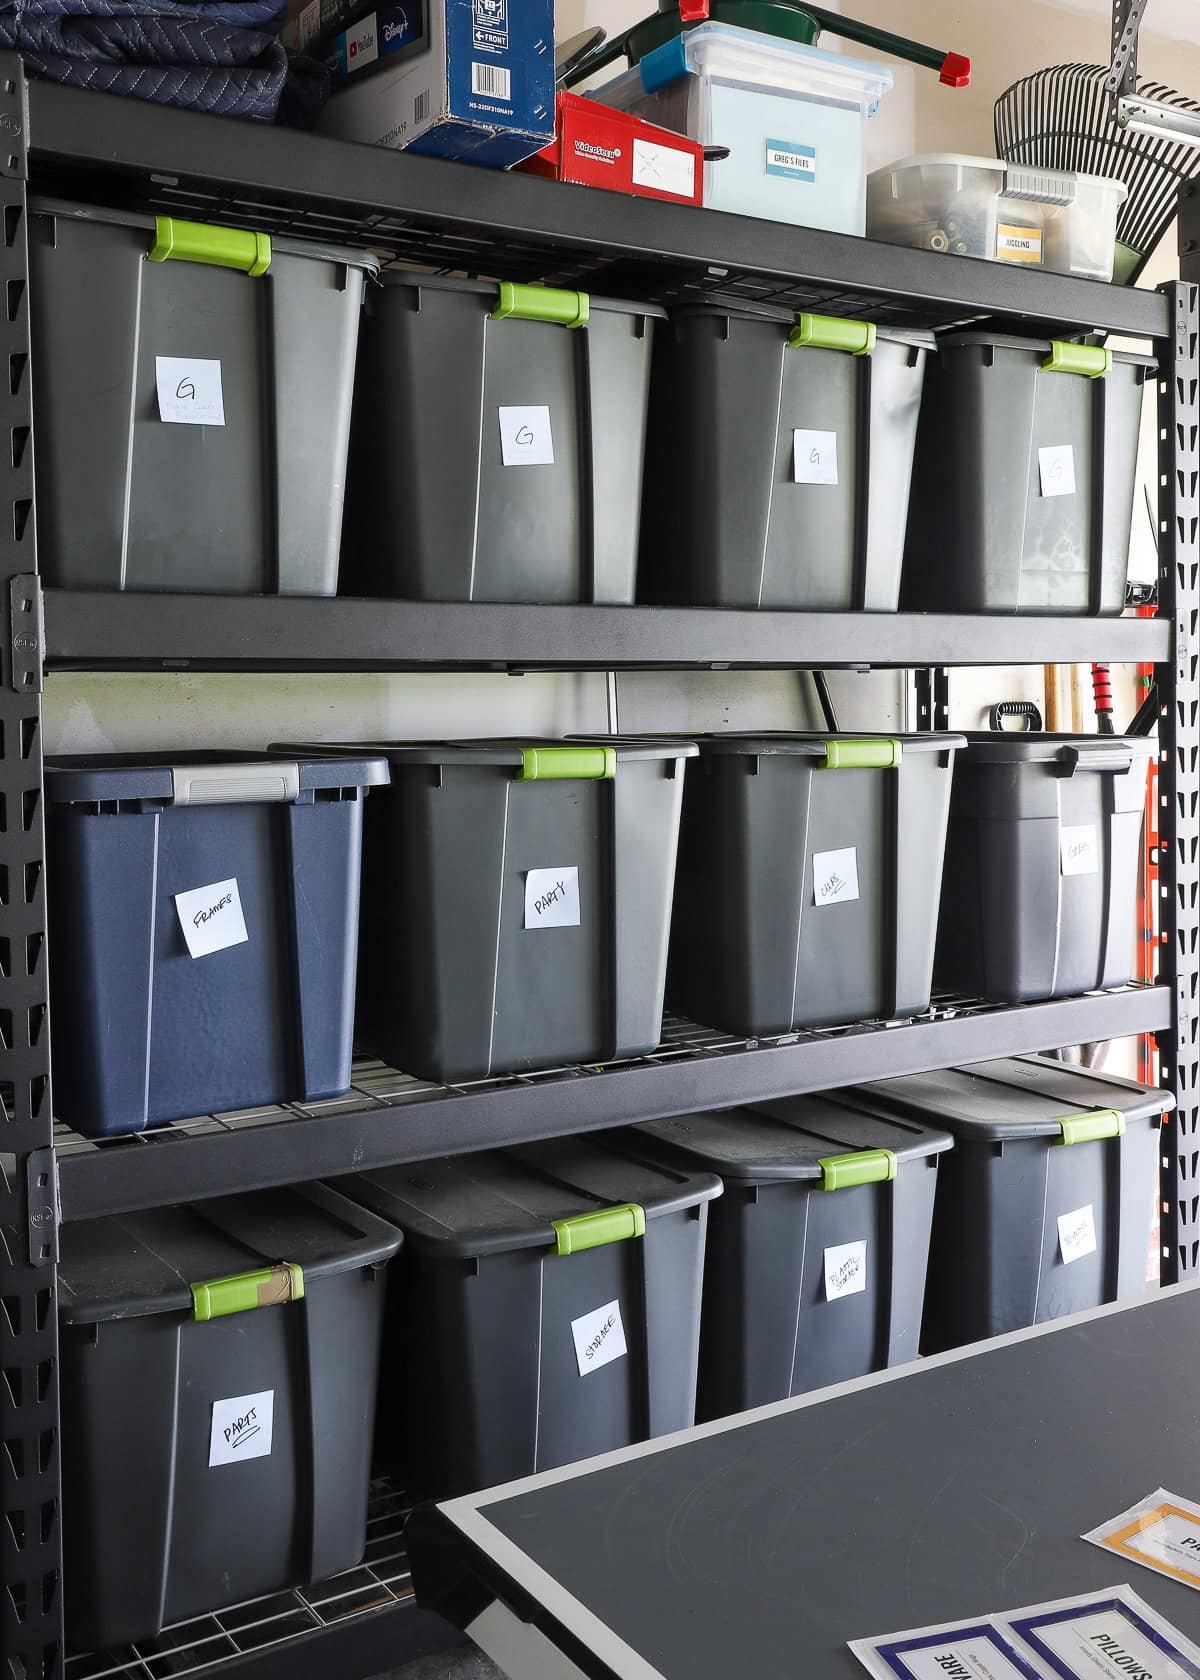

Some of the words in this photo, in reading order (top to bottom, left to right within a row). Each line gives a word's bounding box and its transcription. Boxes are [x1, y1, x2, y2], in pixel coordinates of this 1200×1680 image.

[484, 33, 506, 46] FRONT
[774, 153, 795, 166] GREG'S
[795, 157, 809, 168] FILES
[176, 376, 195, 400] G
[515, 425, 534, 446] G
[810, 448, 820, 465] G
[193, 893, 232, 929] FRAMES
[534, 880, 566, 915] PARTY
[585, 1314, 617, 1360] STORAGE
[223, 1407, 257, 1443] PARTS
[1090, 1633, 1153, 1680] PILLOWS
